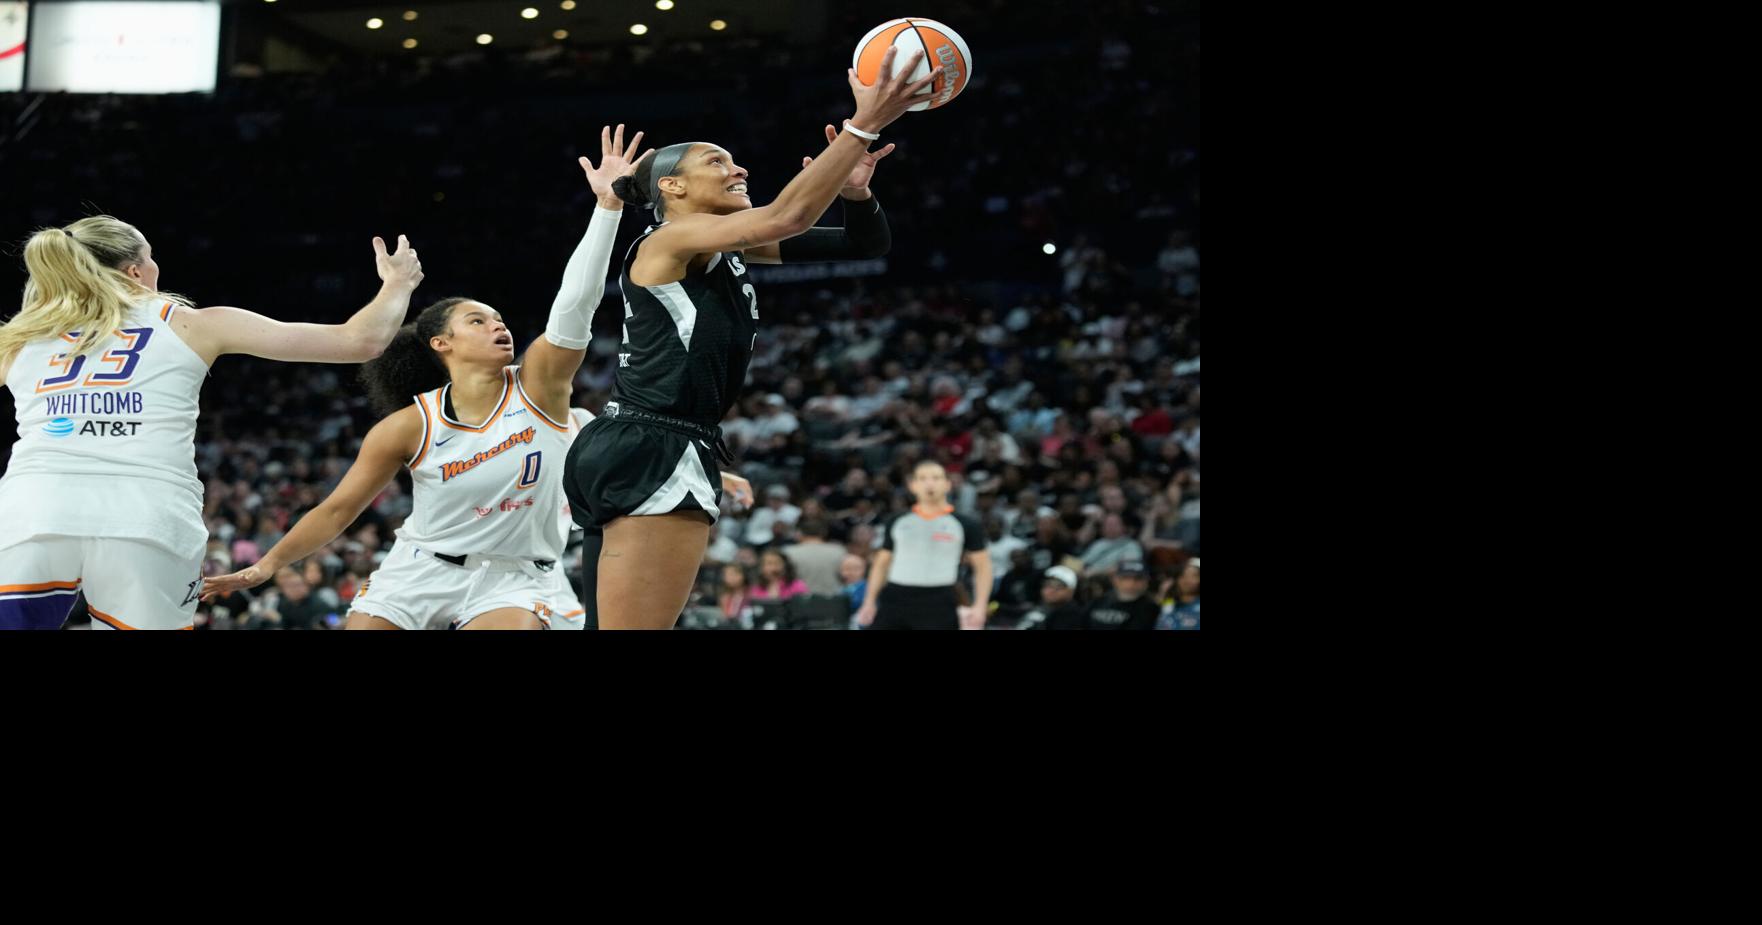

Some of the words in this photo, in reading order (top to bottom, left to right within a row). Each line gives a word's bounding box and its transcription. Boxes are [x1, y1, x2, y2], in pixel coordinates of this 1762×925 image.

[35, 327, 154, 393] 33
[47, 392, 143, 415] WHITCOMB
[80, 421, 142, 436] AT&T
[439, 426, 536, 482] Mercury
[516, 451, 542, 489] 0
